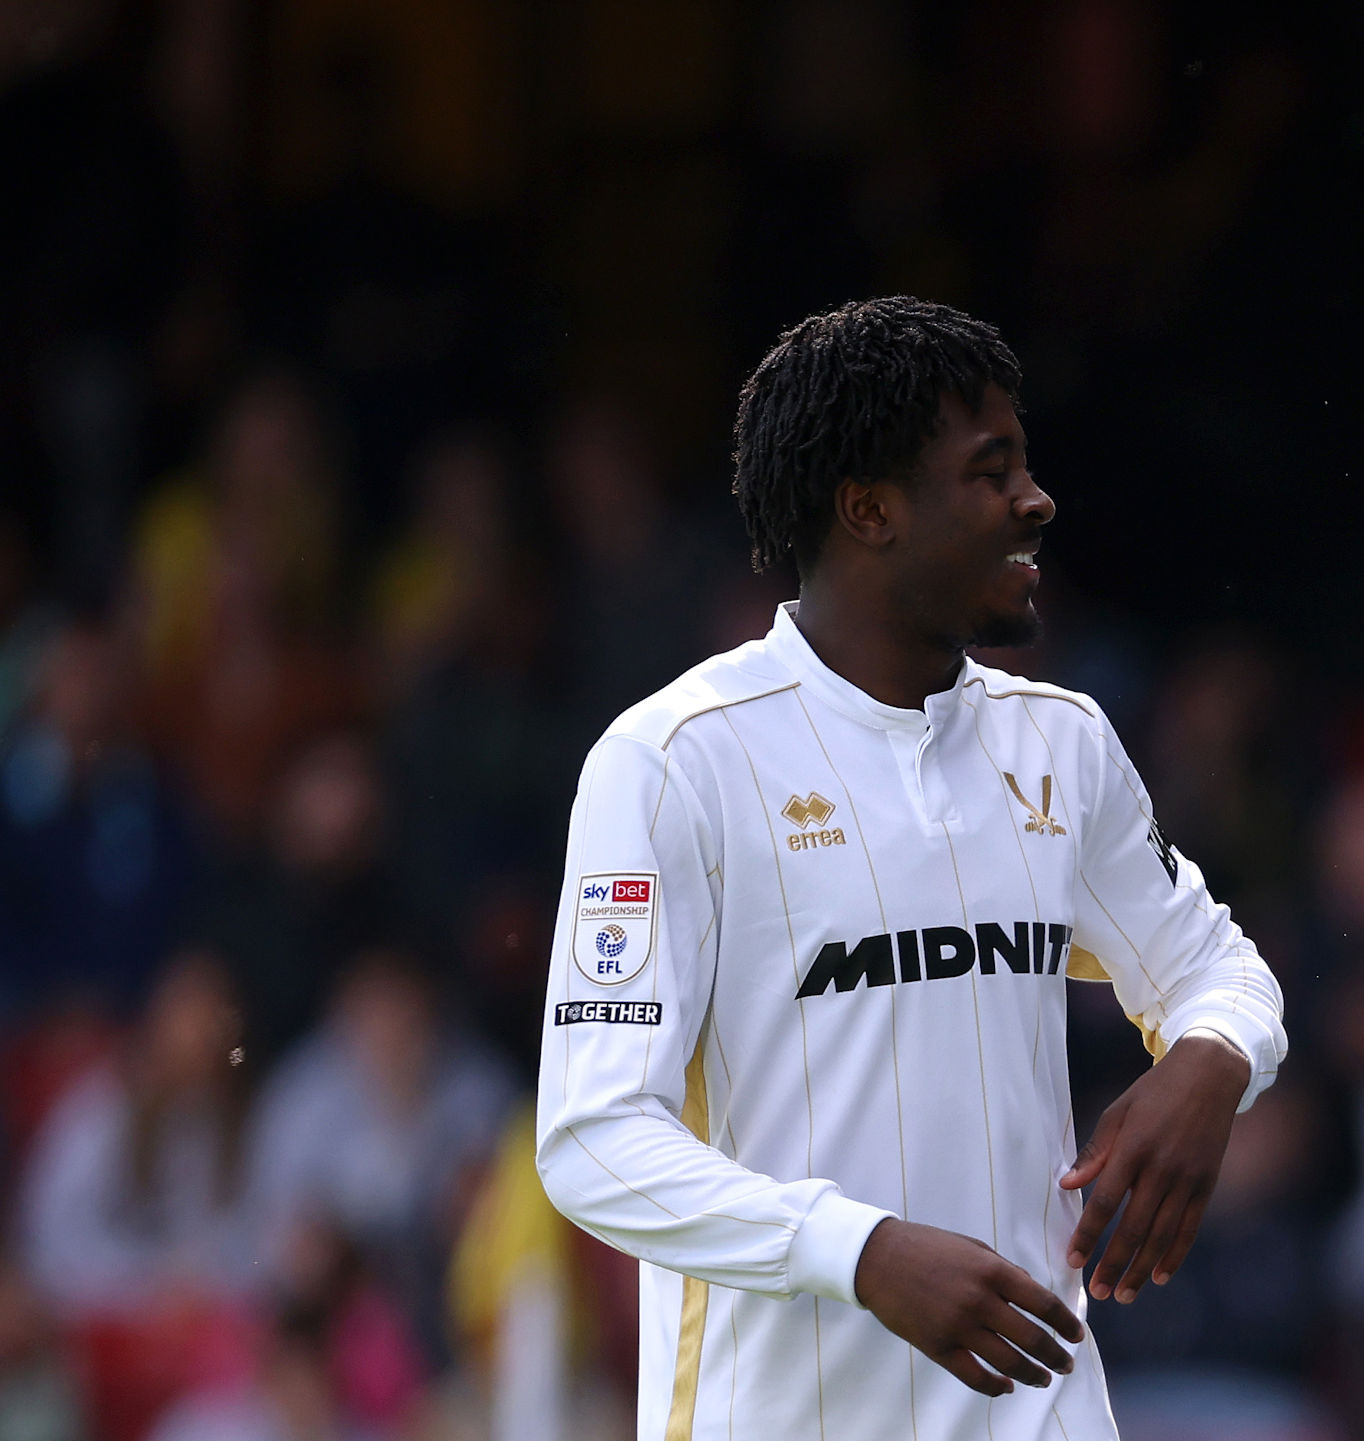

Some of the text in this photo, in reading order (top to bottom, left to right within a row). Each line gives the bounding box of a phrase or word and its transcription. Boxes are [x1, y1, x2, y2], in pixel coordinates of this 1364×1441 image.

[786, 827, 847, 852] errea
[583, 882, 646, 902] sky bet
[581, 906, 649, 917] CHAMPIONSHIP
[597, 960, 623, 974] EFL
[795, 921, 1073, 1001] MIDNIT
[558, 1002, 658, 1024] TOGETHER
